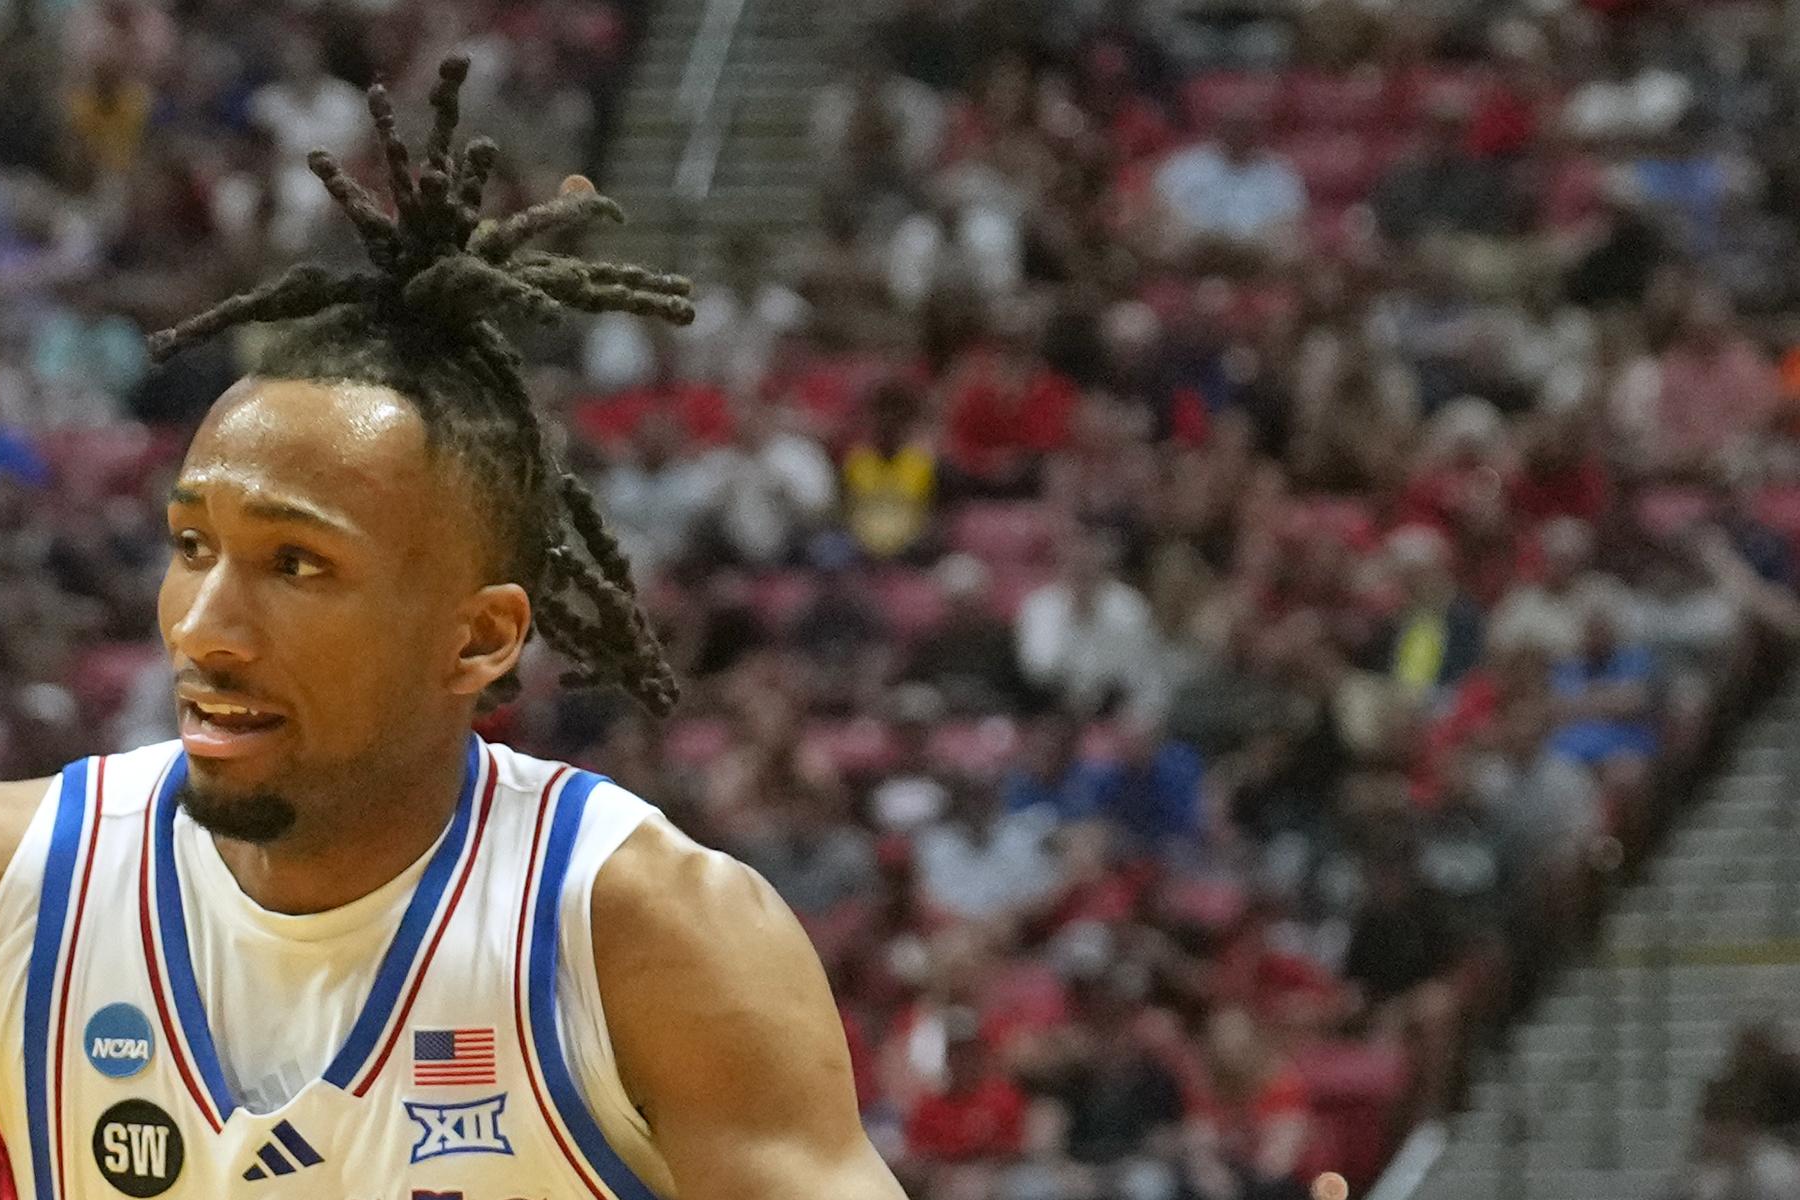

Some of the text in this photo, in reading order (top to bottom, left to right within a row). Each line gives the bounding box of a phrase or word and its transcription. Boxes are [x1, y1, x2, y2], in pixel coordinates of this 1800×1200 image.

[92, 1037, 149, 1060] NCAA
[103, 1122, 169, 1178] SW
[403, 1092, 513, 1164] XII
